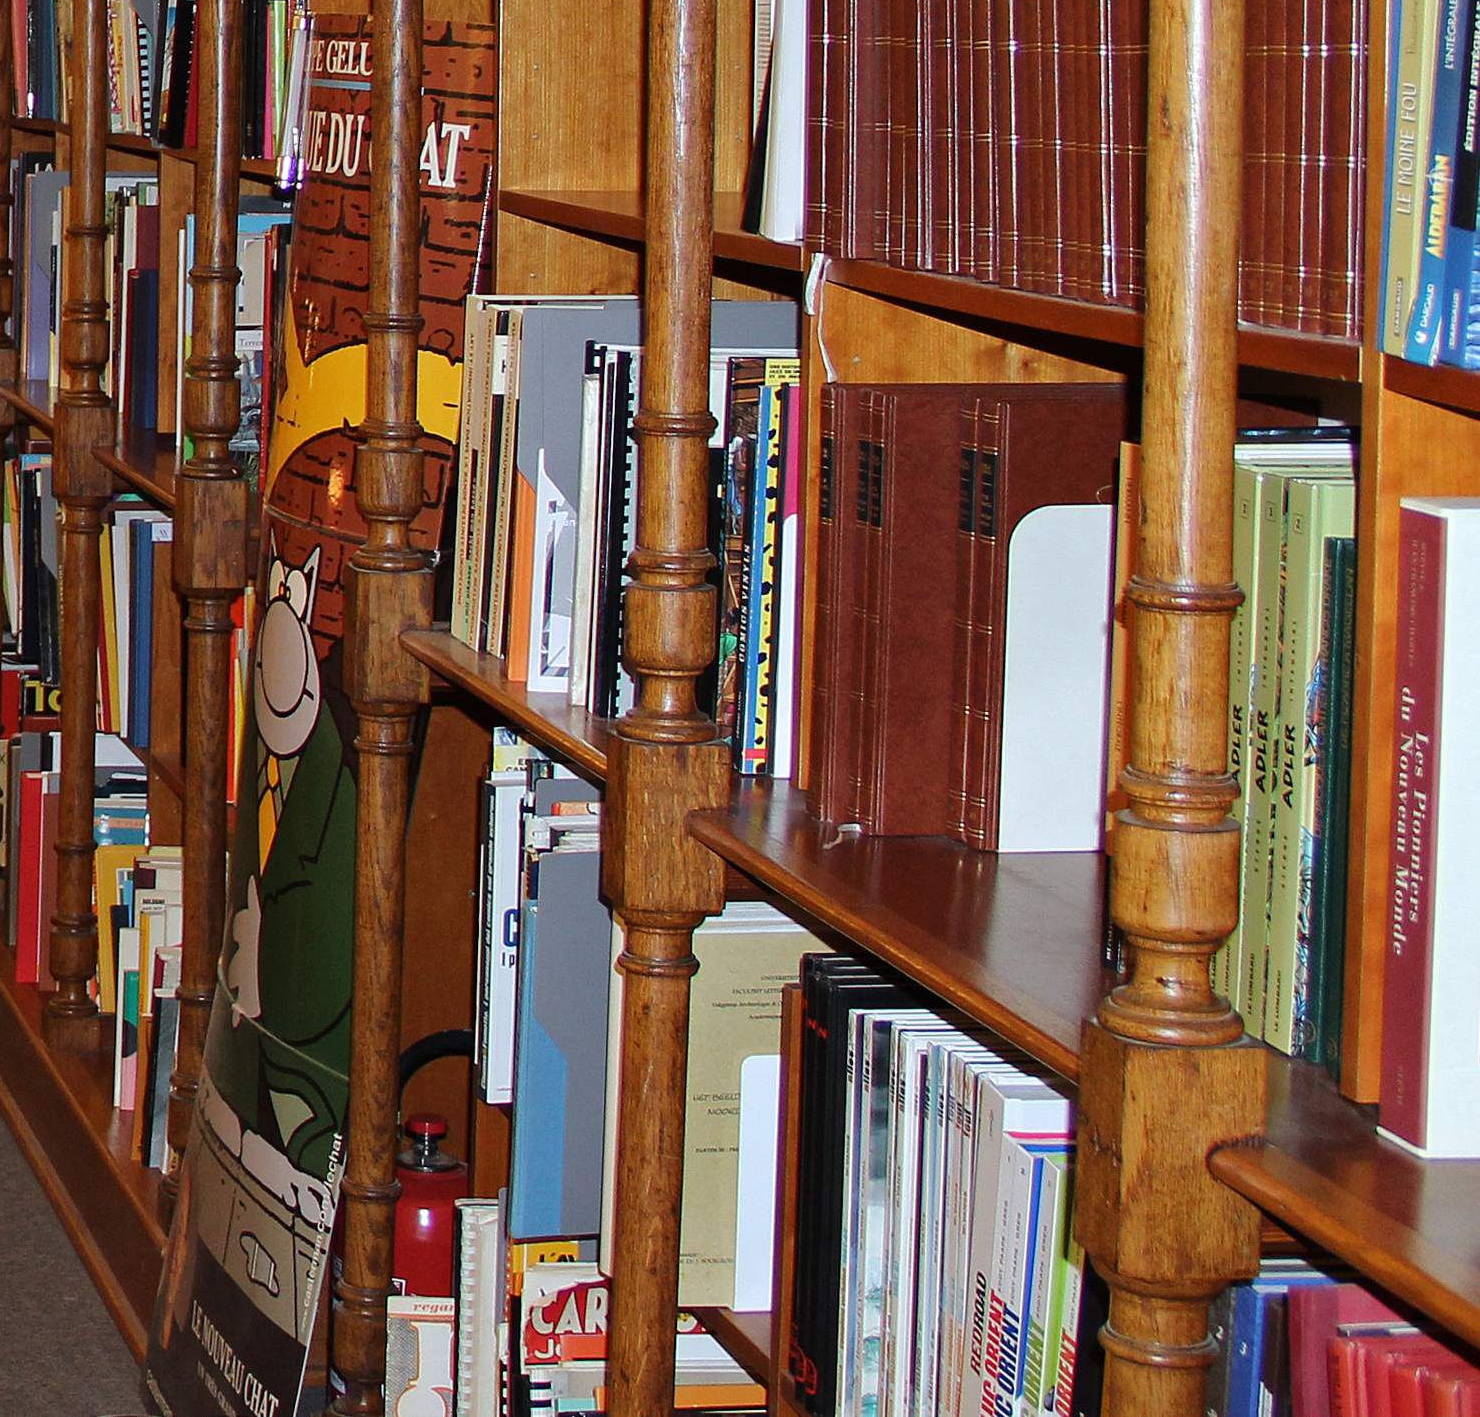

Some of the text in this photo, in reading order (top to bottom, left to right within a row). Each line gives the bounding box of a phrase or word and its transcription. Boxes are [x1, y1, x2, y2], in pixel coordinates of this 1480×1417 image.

[325, 111, 365, 177] DU
[1396, 82, 1417, 215] LE MOINE FOU
[1419, 284, 1435, 328] DARGAUD
[741, 544, 751, 600] VINYLS
[1254, 709, 1269, 794] ADLER
[1281, 724, 1296, 809] ADLER
[1392, 686, 1417, 956] du Nouveau Monde
[1408, 731, 1430, 924] Les Pionniers
[191, 1298, 203, 1339] LE
[202, 1314, 246, 1396] NOUVEAU
[244, 1372, 280, 1417] CHAT
[970, 1271, 987, 1376] REDROAD
[986, 1288, 1003, 1378] ORIENT
[997, 1302, 1020, 1395] ORIENT
[1023, 1314, 1044, 1409] ORIENT
[1055, 1327, 1077, 1417] ORIENT
